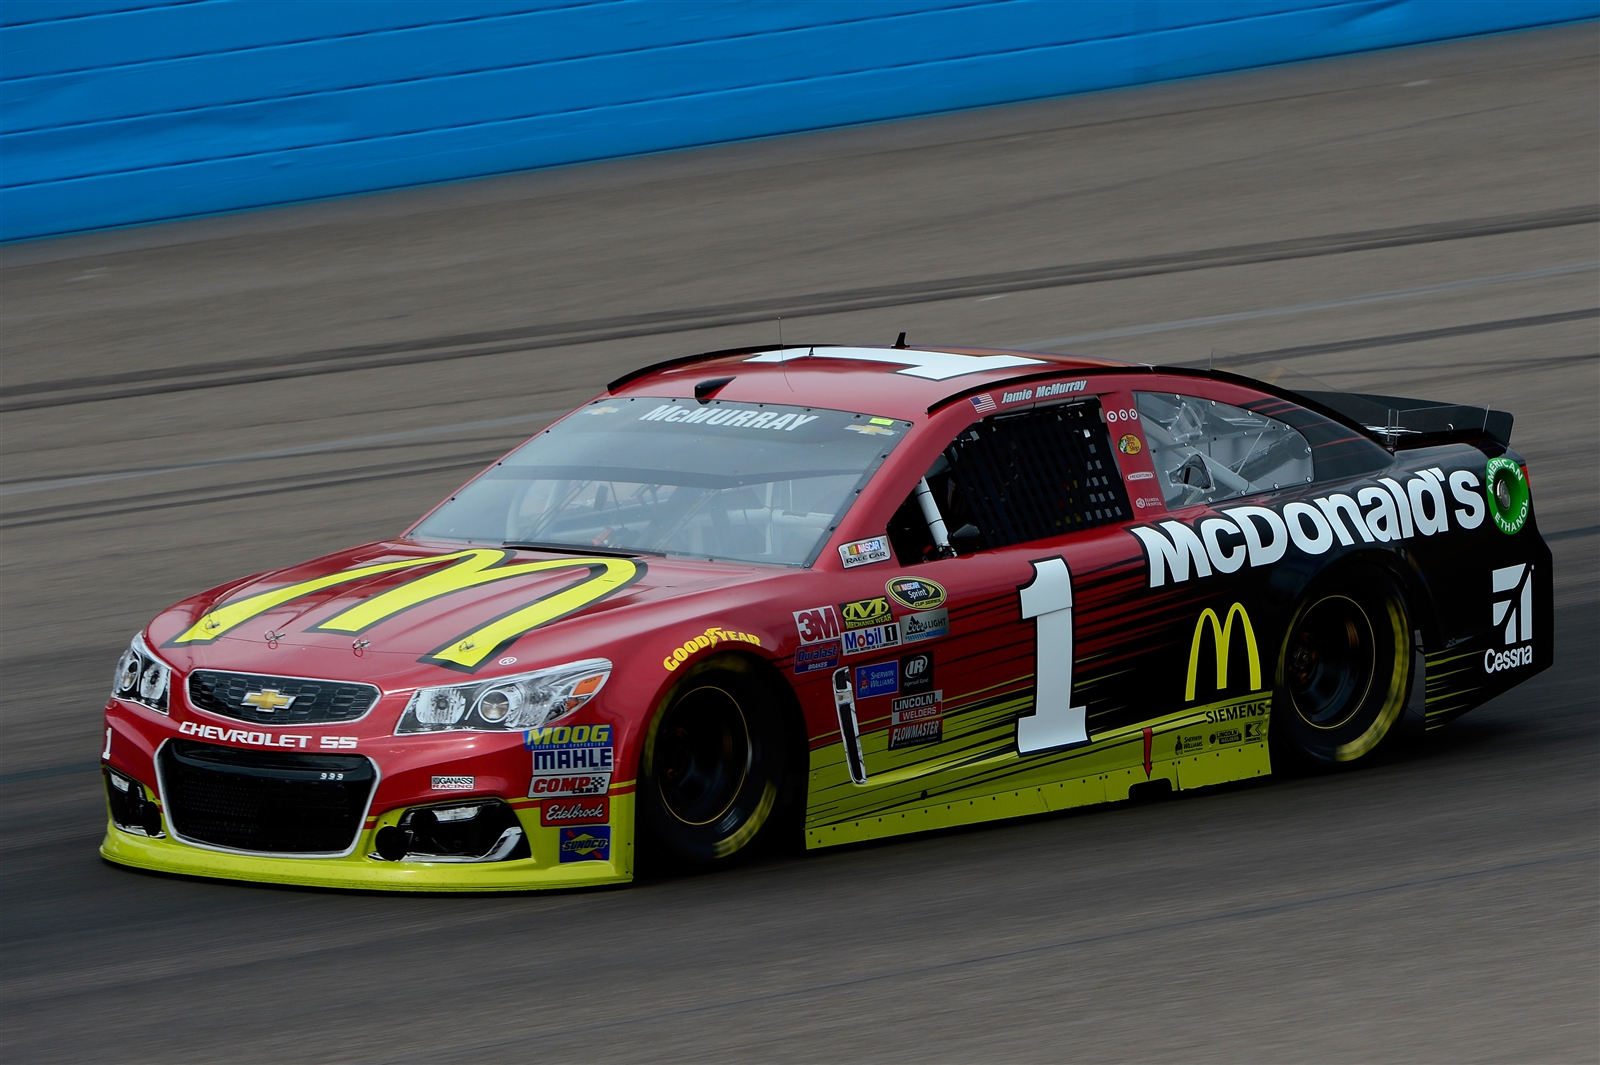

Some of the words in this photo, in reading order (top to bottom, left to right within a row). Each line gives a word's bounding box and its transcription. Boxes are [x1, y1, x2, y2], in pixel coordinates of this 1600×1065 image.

[1001, 389, 1033, 404] Jamie
[1036, 380, 1087, 398] McMurray
[639, 404, 819, 432] McMURRAY
[1487, 458, 1524, 495] AMERICAN
[1494, 499, 1529, 533] ETHANOL
[1131, 467, 1486, 588] McDonald's
[857, 540, 881, 554] NASCAR
[846, 555, 868, 564] RACE
[869, 551, 886, 559] CAR
[900, 581, 920, 591] NASCAR
[907, 589, 927, 599] Sprint
[797, 608, 839, 643] 3M
[845, 619, 875, 630] MECHANIX
[875, 613, 892, 624] WEAR
[928, 617, 947, 629] LIGHT
[844, 627, 882, 650] Mobil
[663, 629, 761, 672] GOODYEAR
[797, 644, 838, 663] Duralast
[1018, 557, 1088, 753] 1
[1484, 645, 1533, 674] Cessna
[807, 661, 828, 671] BRAKES
[870, 669, 894, 680] SHERWIN
[909, 659, 925, 674] IR
[870, 677, 895, 688] WILLIAMS
[894, 694, 933, 711] LINCOLN
[902, 706, 937, 720] WELDERS
[1205, 703, 1266, 724] SIEMENS
[102, 727, 113, 760] 1
[178, 721, 313, 748] CHEVROLET
[320, 735, 358, 749] SS
[527, 724, 610, 745] MOOG
[891, 720, 939, 748] FLOWMASTER
[534, 748, 612, 770] MAHLE
[533, 776, 591, 793] COMP
[572, 786, 599, 794] CAMS
[545, 803, 604, 821] Edelbrock
[563, 838, 608, 850] SUNOCO
